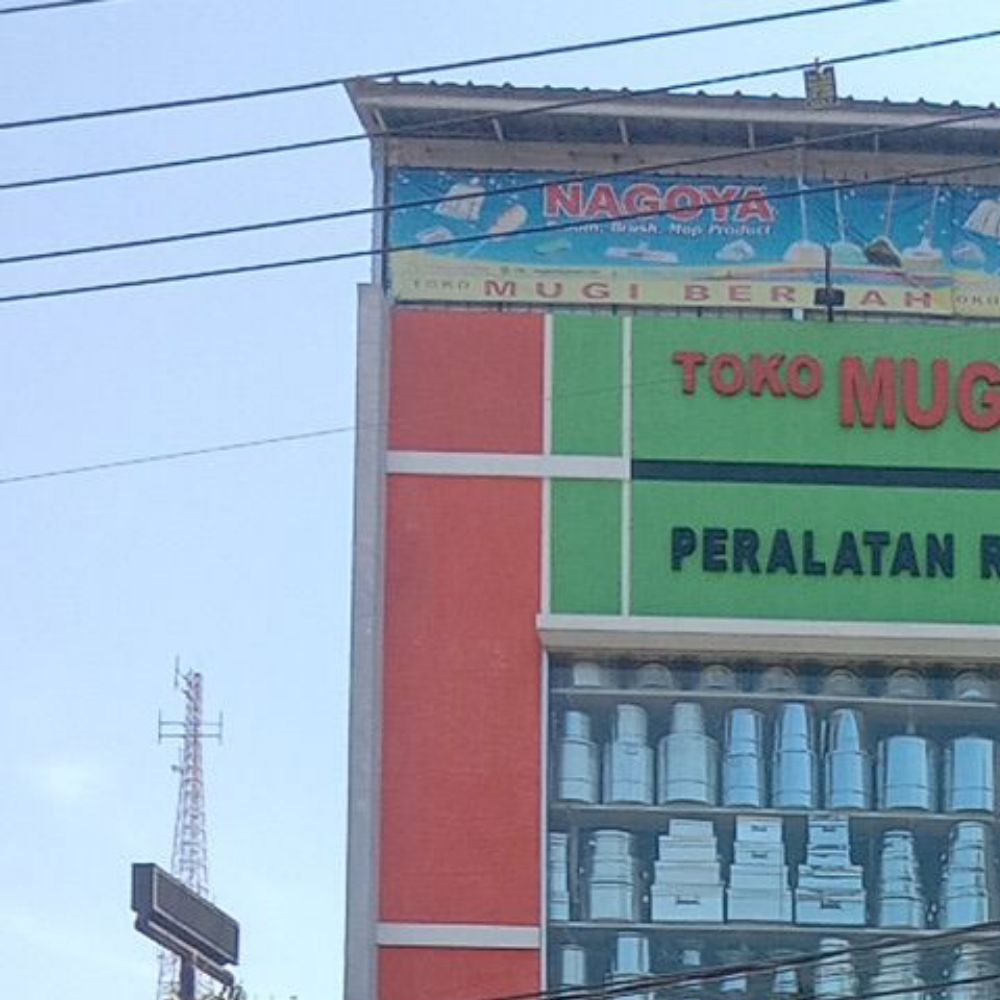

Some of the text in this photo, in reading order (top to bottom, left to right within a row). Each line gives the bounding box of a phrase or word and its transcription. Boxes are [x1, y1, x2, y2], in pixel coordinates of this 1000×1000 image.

[543, 182, 775, 222] NAGOYA
[669, 222, 702, 237] Mop
[708, 223, 771, 236] Product
[484, 279, 640, 300] MUGI
[683, 284, 932, 308] BERAH
[673, 352, 821, 396] TOKO
[671, 527, 955, 578] PERALATAN
